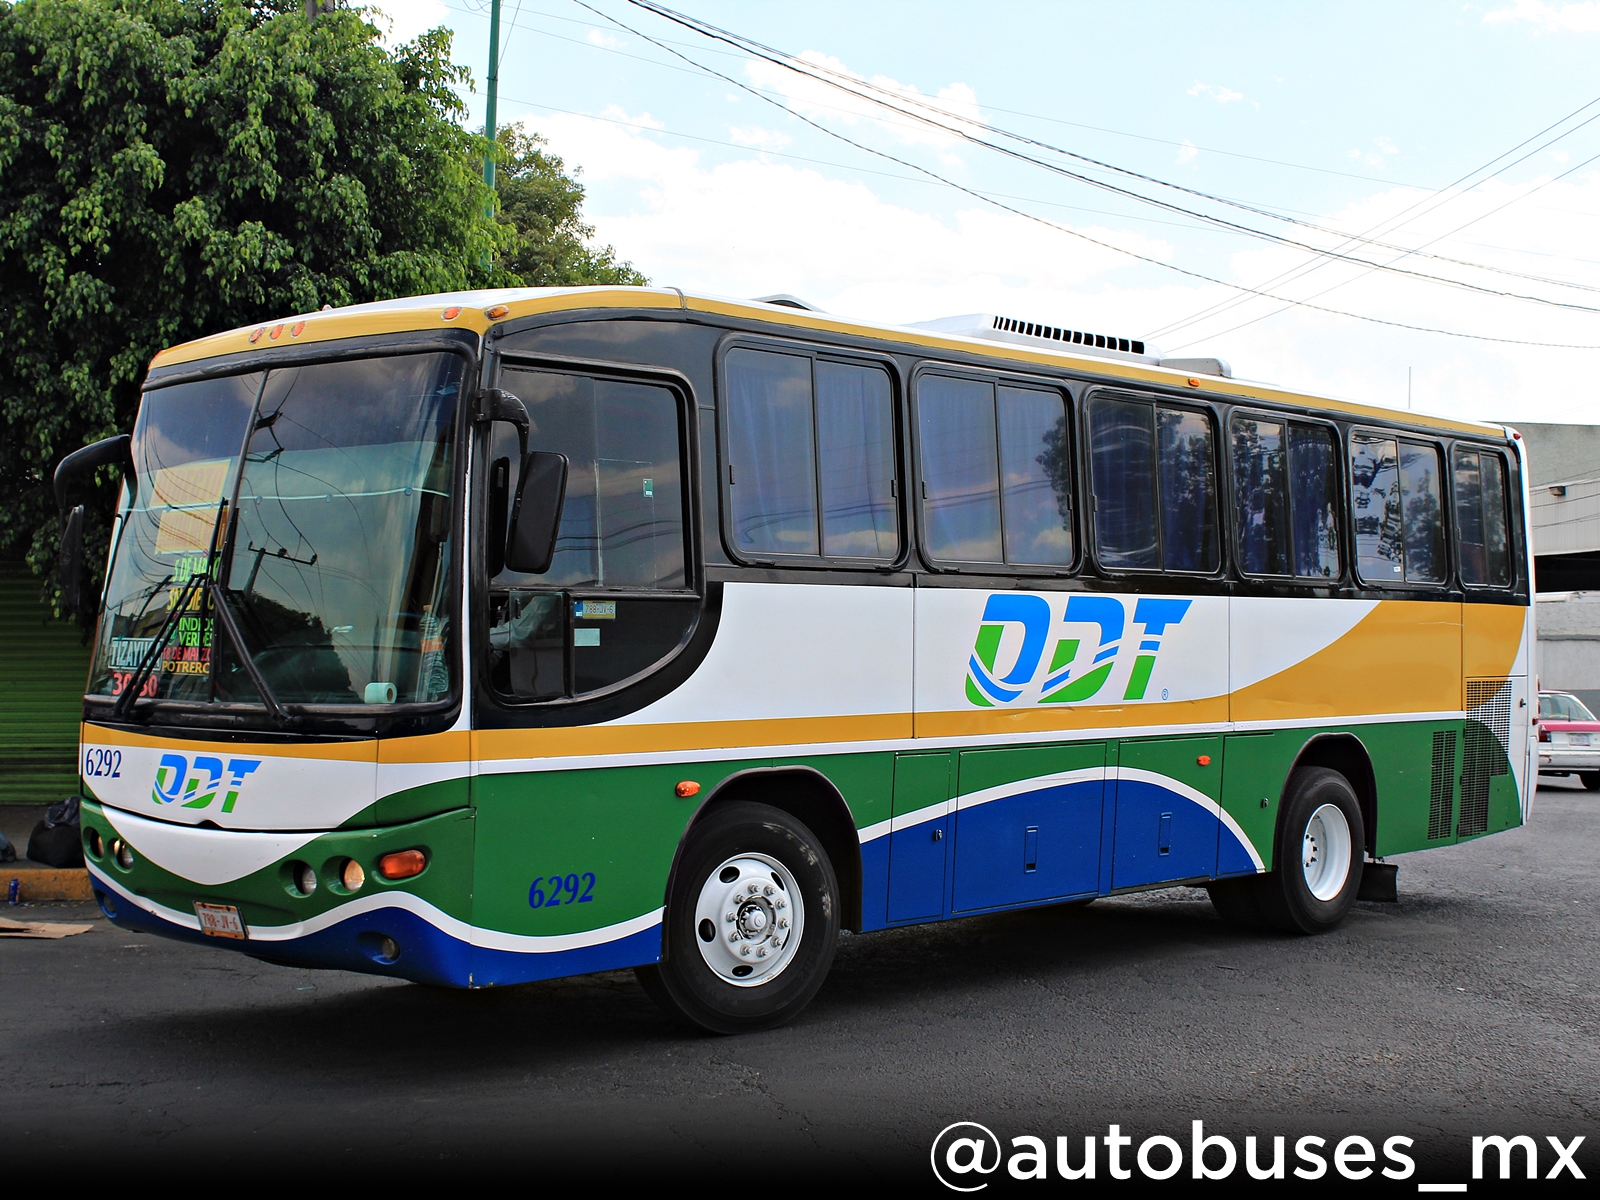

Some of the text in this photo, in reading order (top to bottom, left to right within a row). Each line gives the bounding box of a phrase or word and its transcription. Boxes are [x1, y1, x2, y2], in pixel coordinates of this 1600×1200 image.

[179, 557, 193, 582] DE
[193, 557, 220, 582] MAO
[186, 587, 214, 610] DIEO
[172, 646, 182, 660] DE
[182, 646, 211, 661] MAZO
[86, 748, 122, 778] 6292
[528, 871, 596, 909] 6292
